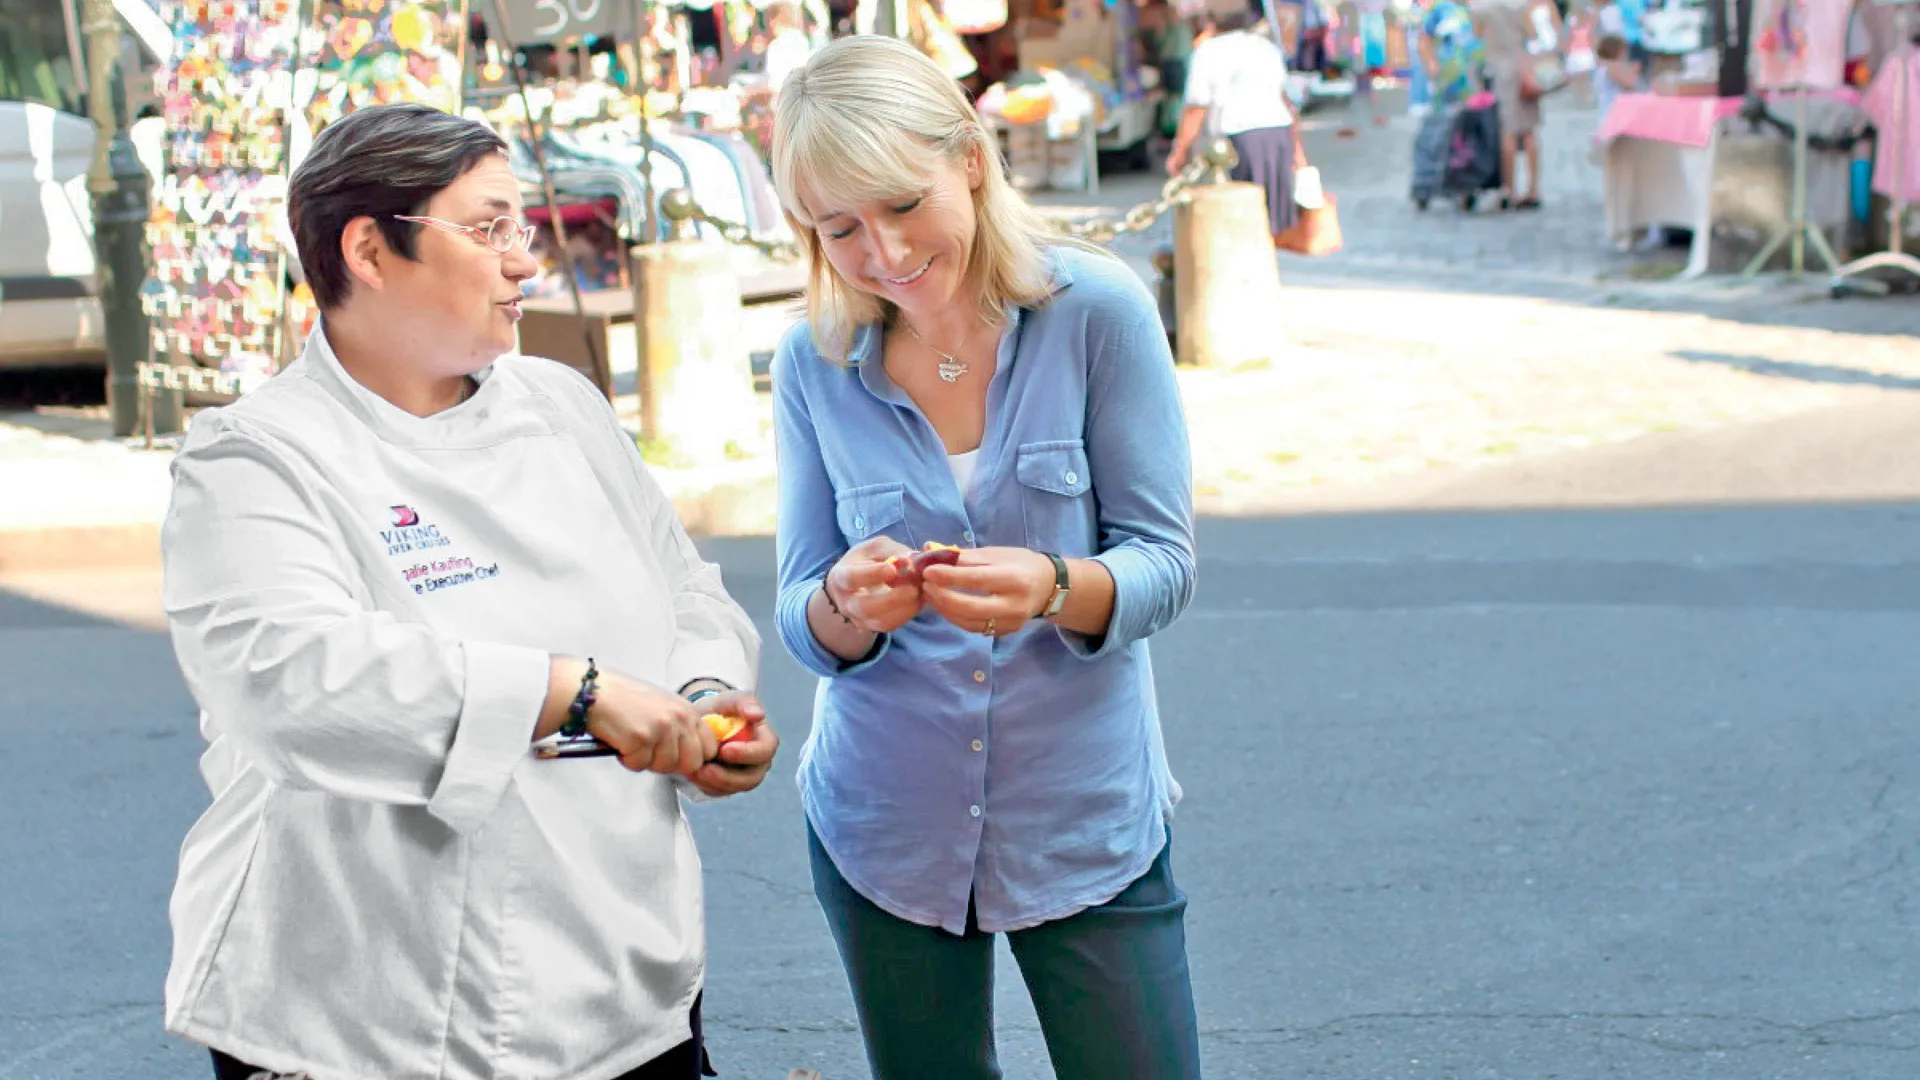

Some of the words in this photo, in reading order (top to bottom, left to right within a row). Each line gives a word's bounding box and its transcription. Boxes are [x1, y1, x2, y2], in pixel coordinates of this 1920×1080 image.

[379, 524, 440, 544] VIKING
[388, 543, 412, 556] IVER
[425, 571, 474, 591] Executive
[475, 562, 499, 579] Chef
